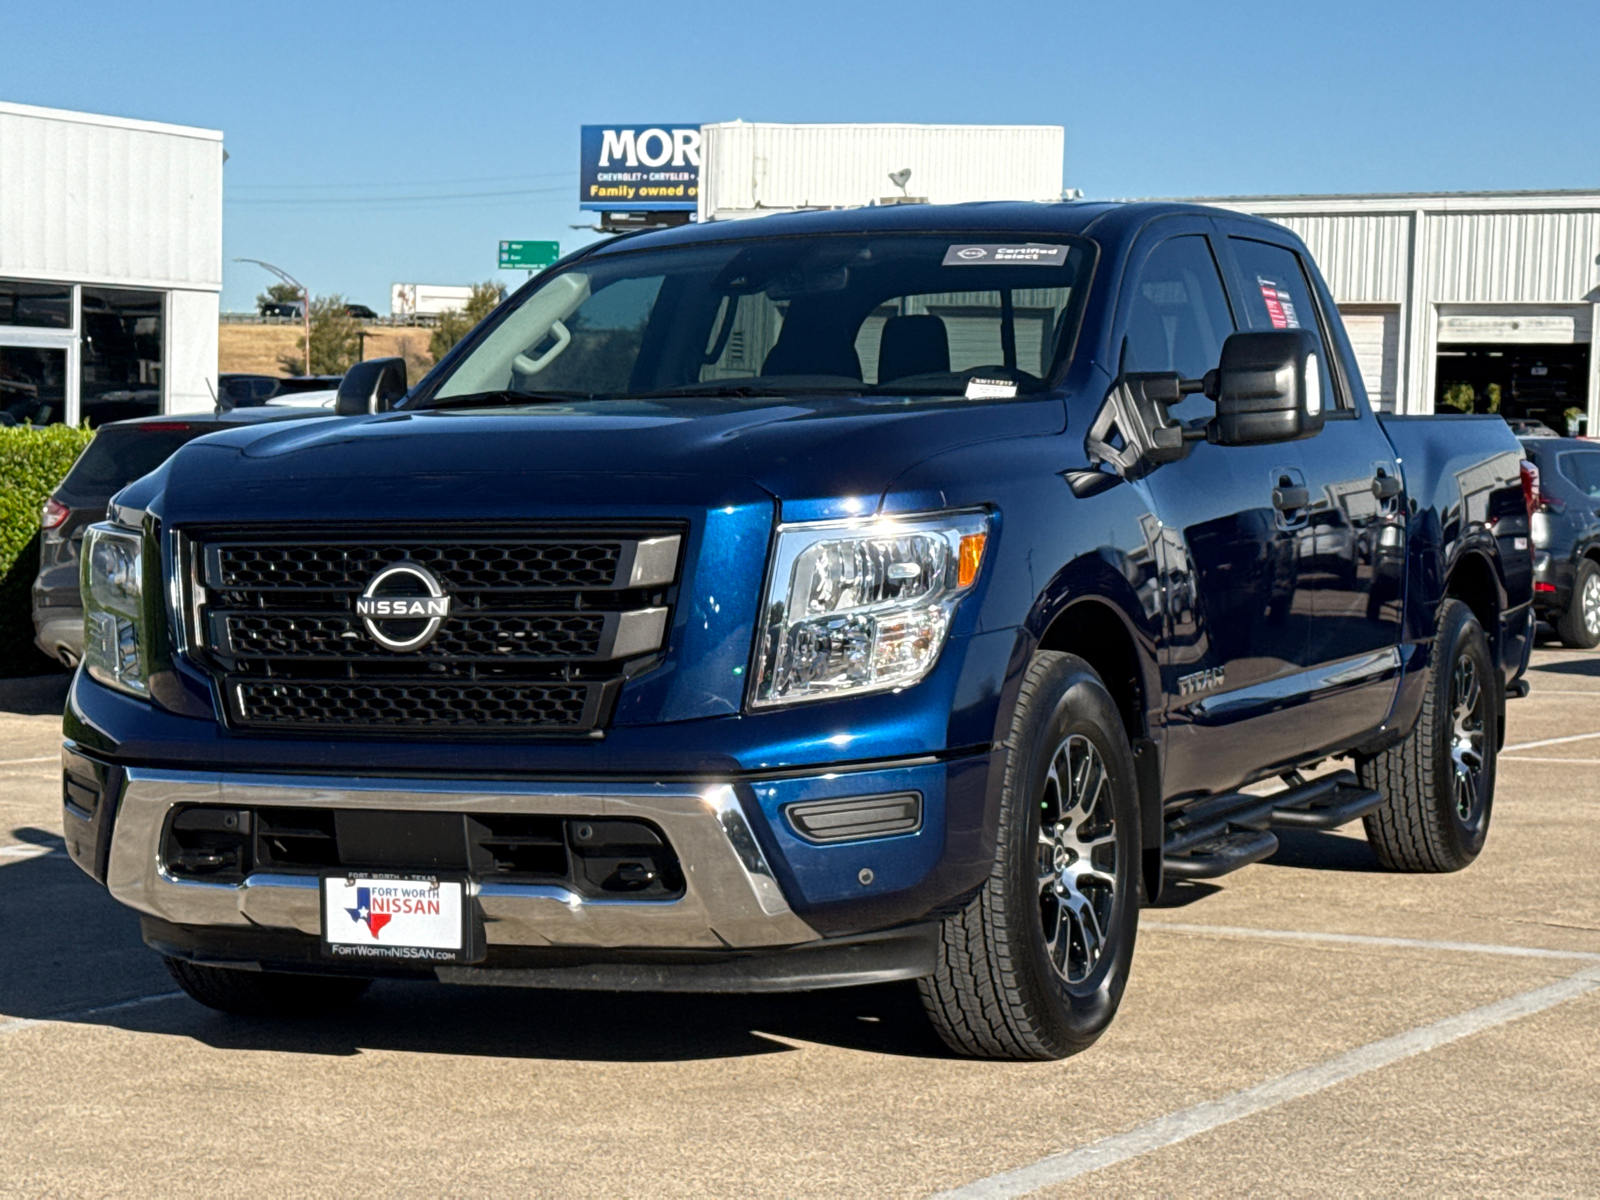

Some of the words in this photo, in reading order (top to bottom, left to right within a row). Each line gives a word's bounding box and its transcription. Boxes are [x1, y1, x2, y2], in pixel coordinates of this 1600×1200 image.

[599, 128, 700, 167] MOR
[597, 172, 642, 181] CHEVROLET
[649, 172, 689, 181] CHRYSLER
[590, 185, 635, 199] Family
[639, 184, 684, 196] owned
[357, 601, 445, 615] NISSAN
[1178, 666, 1225, 696] TITAN
[372, 887, 398, 897] FORT
[401, 888, 440, 899] WORTH
[372, 897, 440, 915] NISSAN
